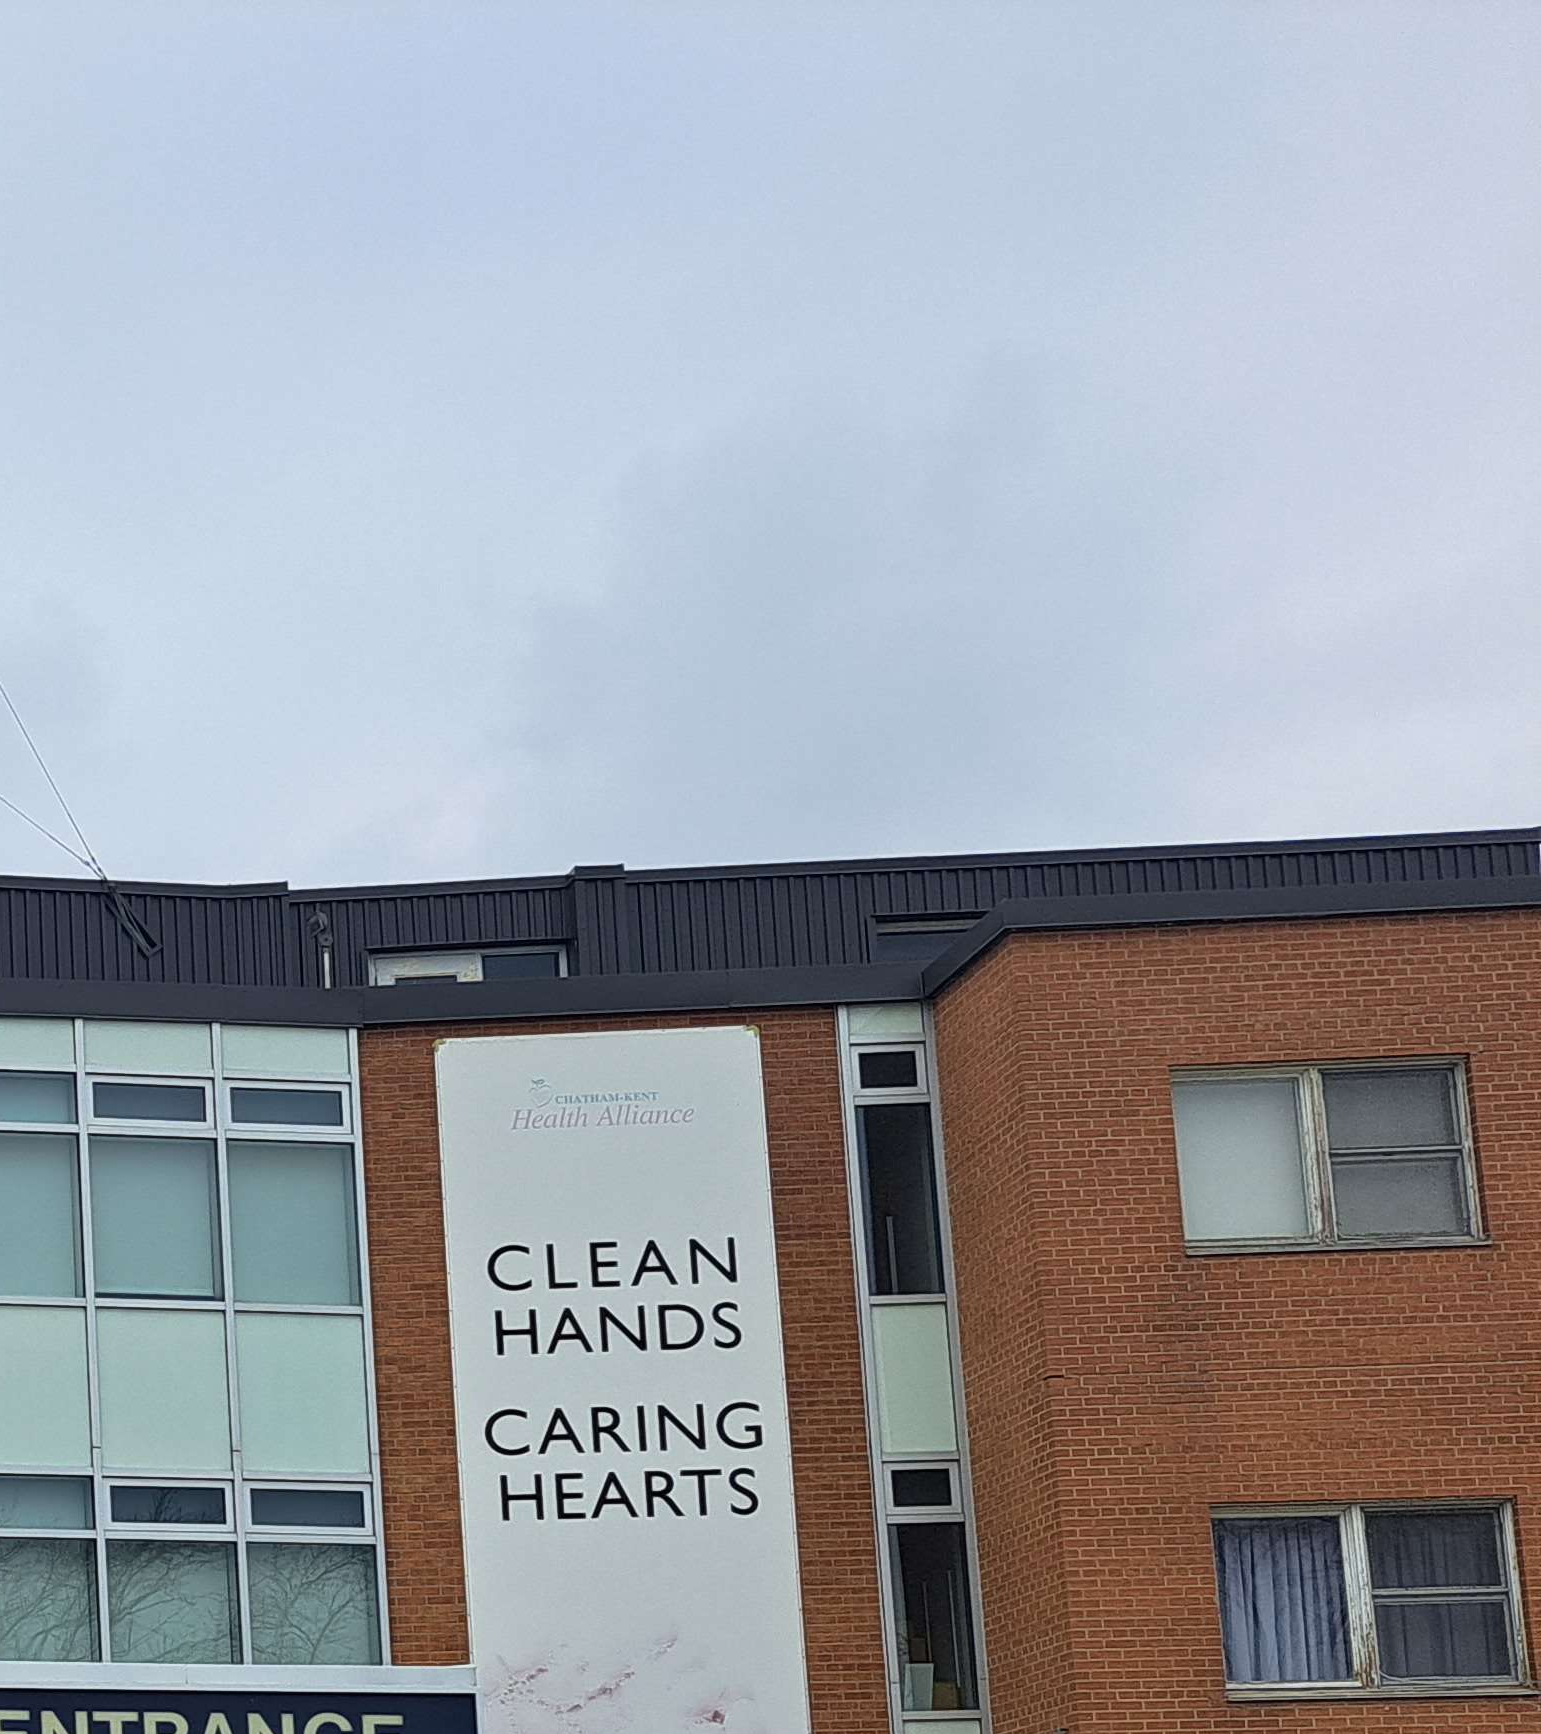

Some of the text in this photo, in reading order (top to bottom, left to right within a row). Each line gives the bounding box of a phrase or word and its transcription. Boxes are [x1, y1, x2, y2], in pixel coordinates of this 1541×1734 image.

[511, 1103, 695, 1130] Health Alliance
[555, 1092, 659, 1104] CHATHAM-KENT
[487, 1237, 738, 1291] CLEAN
[494, 1301, 742, 1356] HANDS
[484, 1402, 763, 1456] CARING
[499, 1468, 759, 1522] HEARTS
